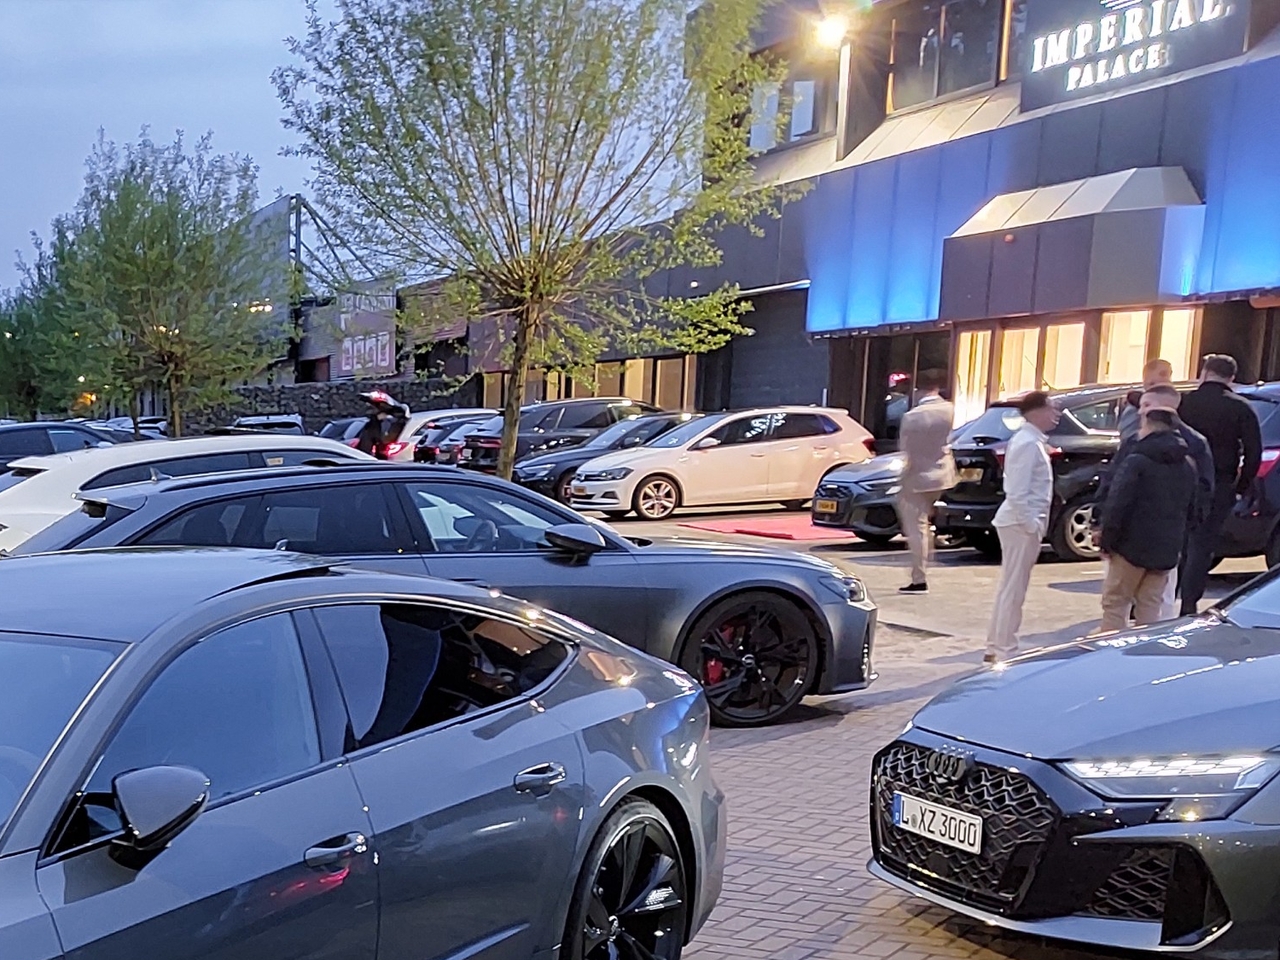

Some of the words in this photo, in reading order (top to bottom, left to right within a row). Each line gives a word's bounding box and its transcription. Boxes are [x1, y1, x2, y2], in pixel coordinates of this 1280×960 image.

[1031, 0, 1224, 73] IMPERIAL
[1066, 43, 1162, 91] PALACE
[902, 800, 910, 825] L
[918, 806, 937, 835] XZ
[939, 813, 977, 847] 3000
